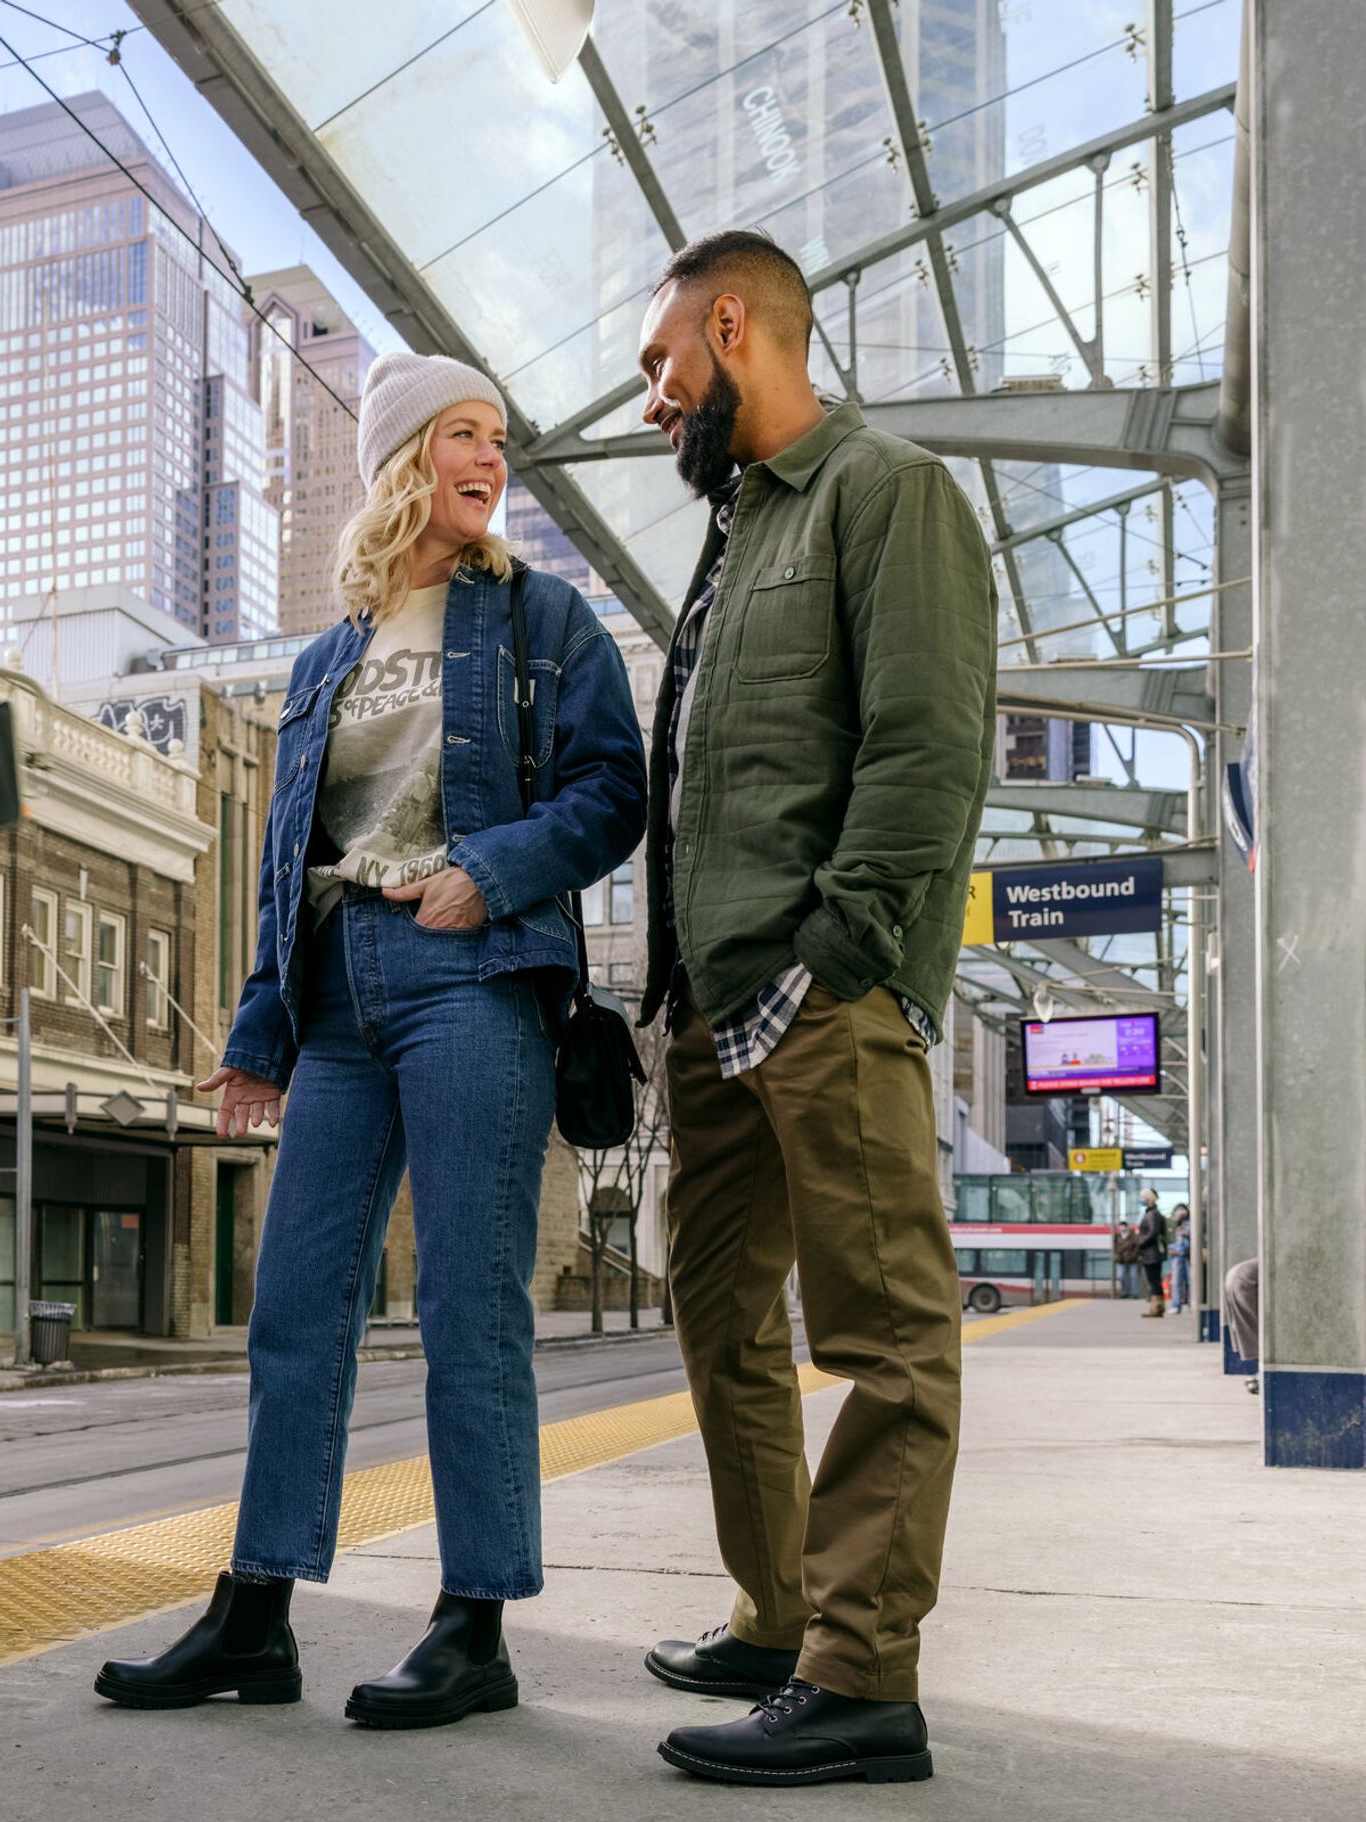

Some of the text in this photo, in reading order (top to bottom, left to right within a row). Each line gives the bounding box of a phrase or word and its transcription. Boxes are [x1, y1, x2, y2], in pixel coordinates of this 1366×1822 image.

[742, 85, 802, 182] CHINOOK
[356, 856, 390, 888] NY
[1006, 876, 1135, 904] Westbound
[1008, 908, 1064, 928] Train
